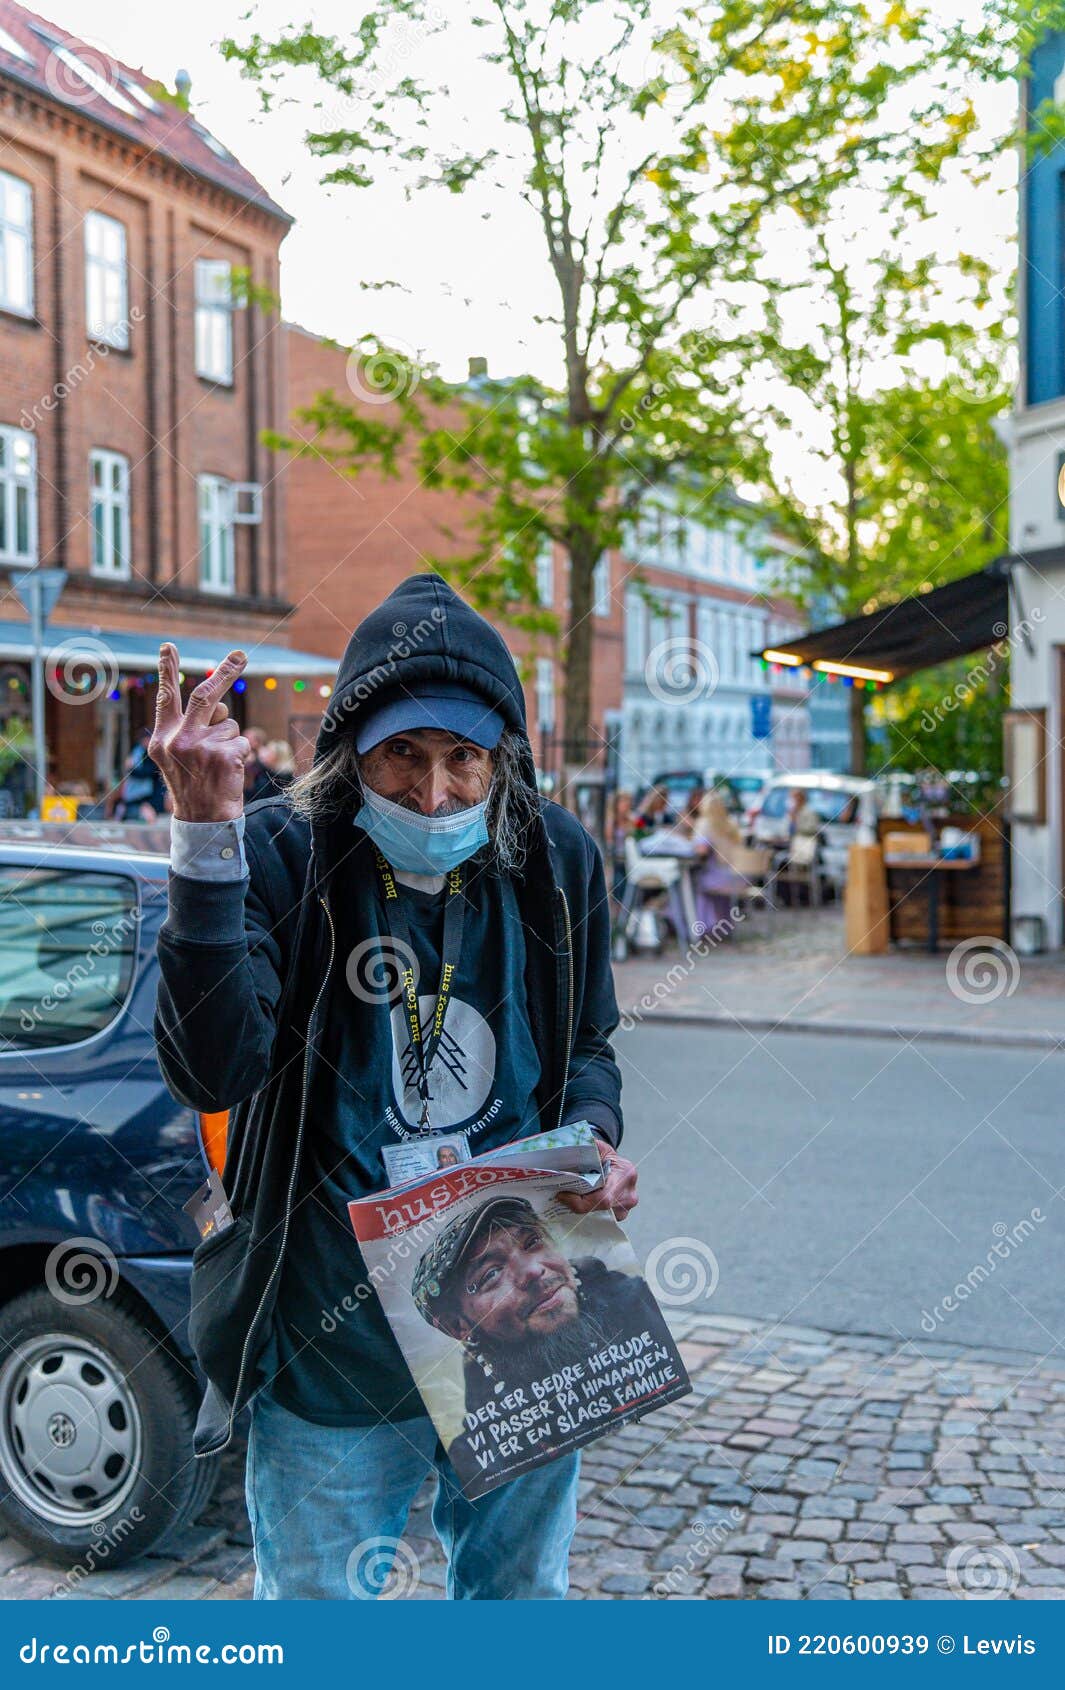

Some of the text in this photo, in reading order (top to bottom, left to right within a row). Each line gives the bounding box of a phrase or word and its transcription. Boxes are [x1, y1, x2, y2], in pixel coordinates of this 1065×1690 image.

[382, 873, 398, 899] hus
[402, 968, 421, 1043] hus forbi
[433, 963, 454, 1036] hus forbi
[464, 1098, 503, 1136] VENTION
[375, 1184, 452, 1234] hus
[464, 1400, 501, 1431] DER
[531, 1363, 585, 1400] BEDRE
[588, 1331, 660, 1374] HERUDE,
[467, 1346, 674, 1451] VI PASSER PÅ HINANDEN.
[475, 1450, 495, 1470] VI
[499, 1435, 524, 1458] ER
[527, 1423, 552, 1445] EN
[557, 1397, 612, 1434] SLAGS
